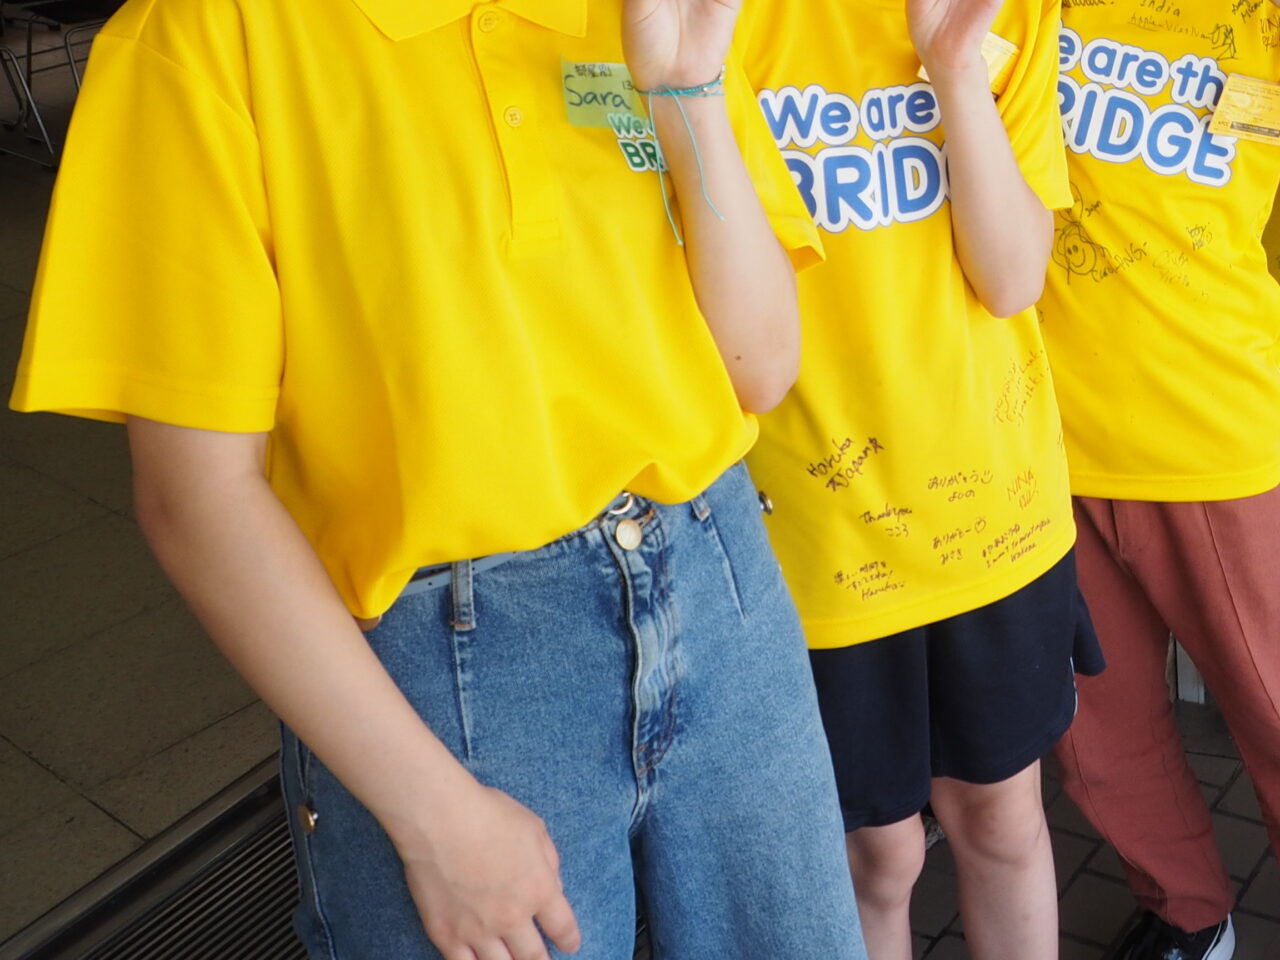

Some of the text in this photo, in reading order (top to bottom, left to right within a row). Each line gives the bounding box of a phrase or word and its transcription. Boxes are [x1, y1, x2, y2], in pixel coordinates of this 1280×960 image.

[564, 74, 632, 110] Sara
[1087, 43, 1164, 89] are
[1176, 60, 1225, 107] th
[610, 114, 643, 136] We
[760, 89, 937, 141] We are
